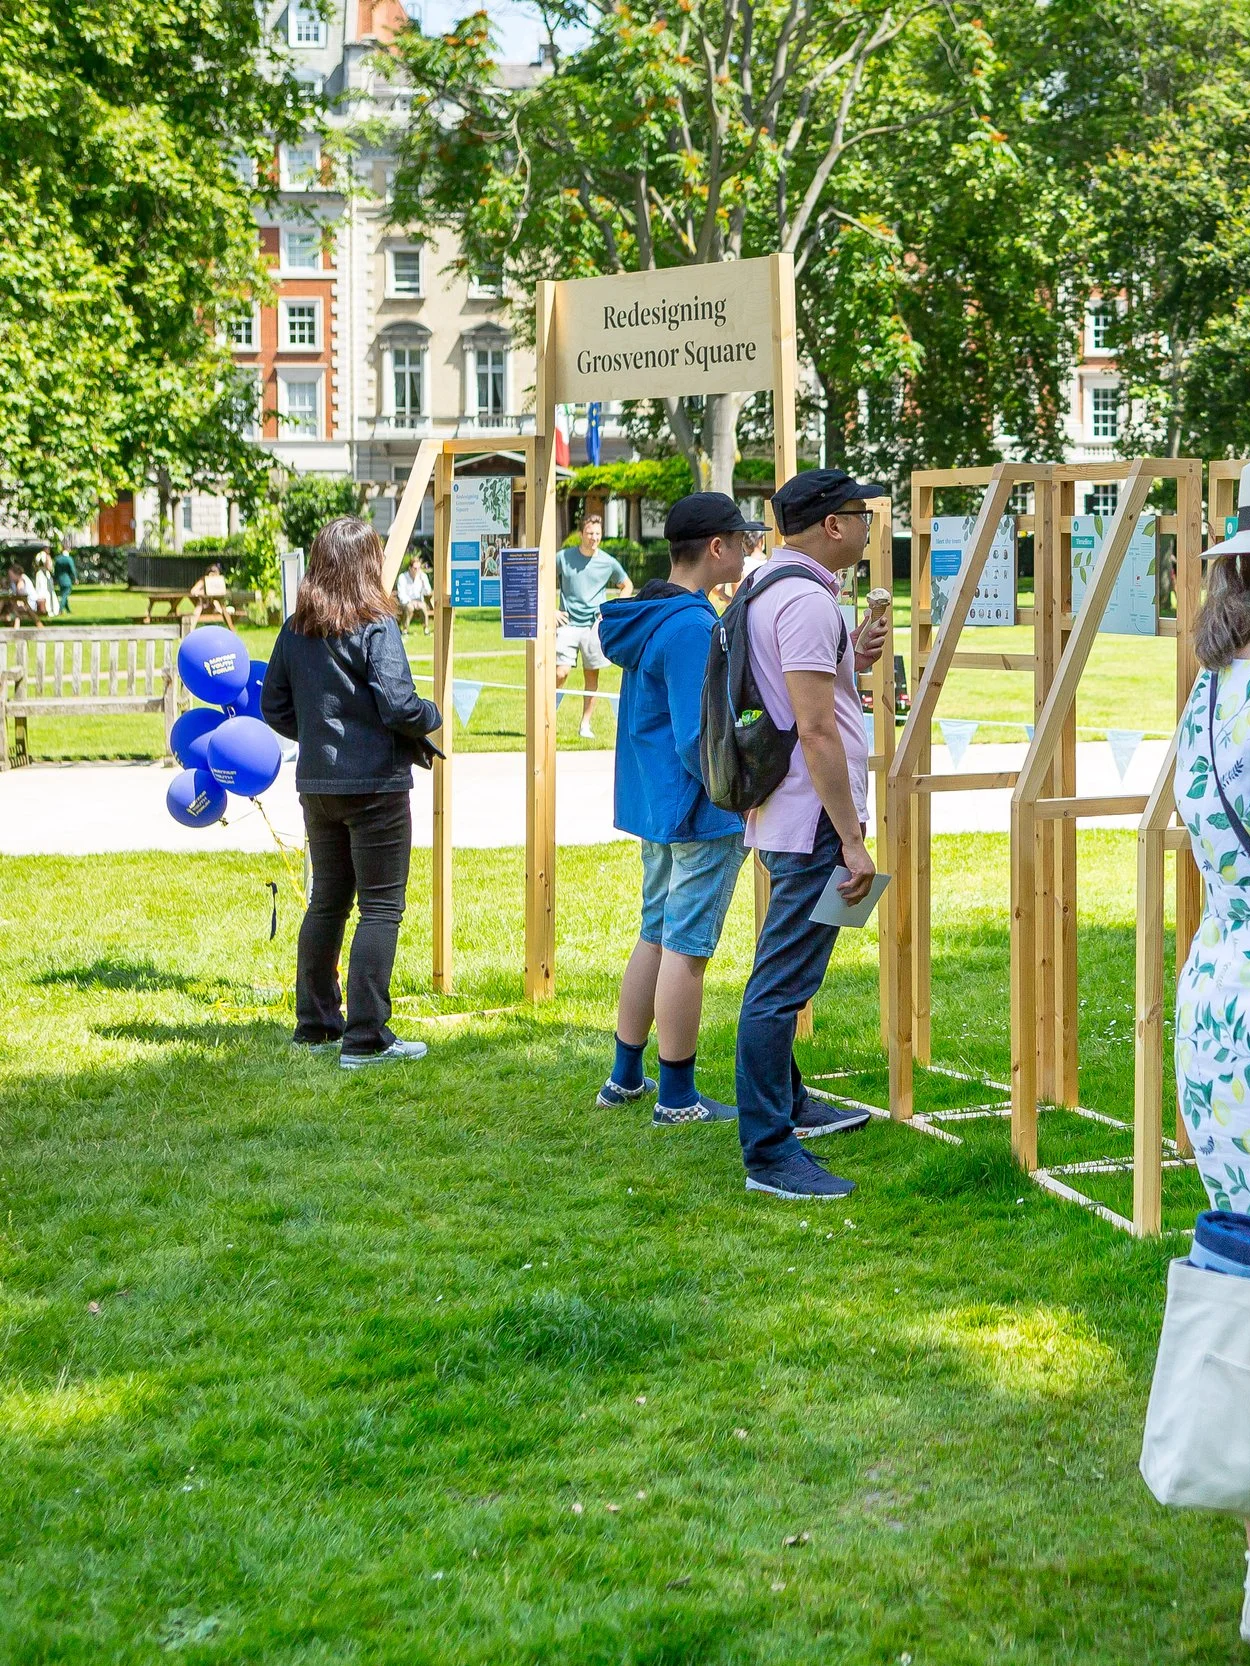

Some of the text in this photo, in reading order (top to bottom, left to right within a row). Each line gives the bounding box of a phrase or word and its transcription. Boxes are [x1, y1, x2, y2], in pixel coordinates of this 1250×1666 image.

[603, 295, 727, 332] Redesigning
[577, 340, 757, 375] Grosvenor Square
[211, 659, 234, 670] YOUTH
